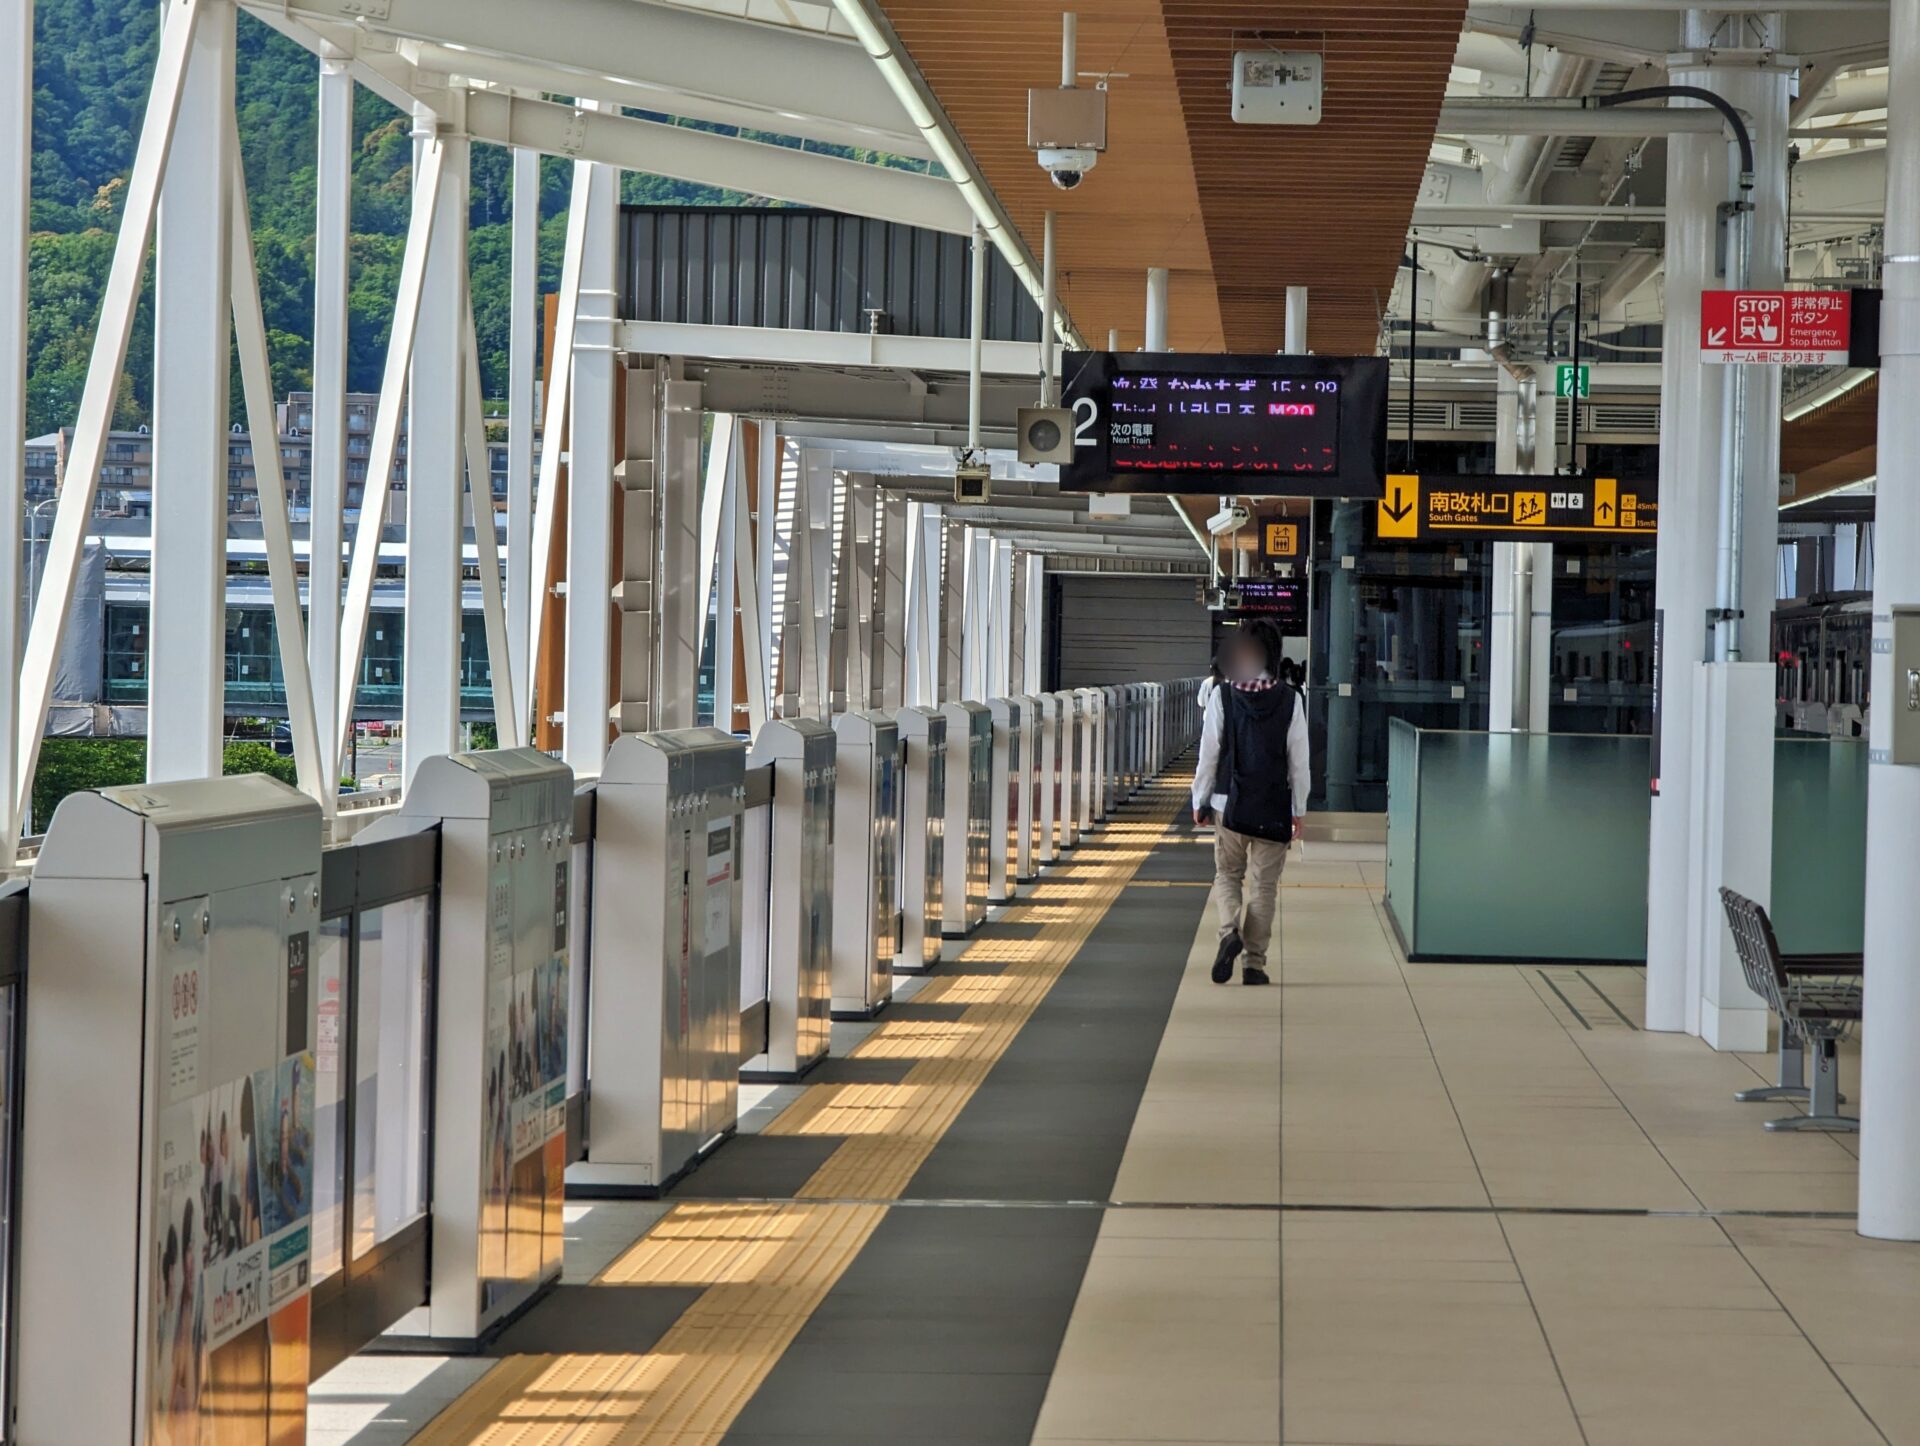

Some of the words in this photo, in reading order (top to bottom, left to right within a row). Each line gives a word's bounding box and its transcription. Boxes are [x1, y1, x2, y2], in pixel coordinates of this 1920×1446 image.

[1739, 300, 1780, 312] STOP
[1791, 296, 1843, 310] 非常停止
[1791, 312, 1829, 324] ボタン
[1790, 327, 1837, 338] Emergency
[1790, 338, 1809, 347] Stop
[1812, 338, 1841, 346] Button
[1722, 352, 1827, 363] ホーム柵にあります
[1072, 397, 1098, 447] 2
[1110, 423, 1153, 436] 次の電車
[1112, 436, 1131, 445] Next
[1131, 437, 1151, 445] Train
[1429, 492, 1509, 513] 南改札口
[1429, 513, 1452, 522] South
[1454, 513, 1478, 523] Gates
